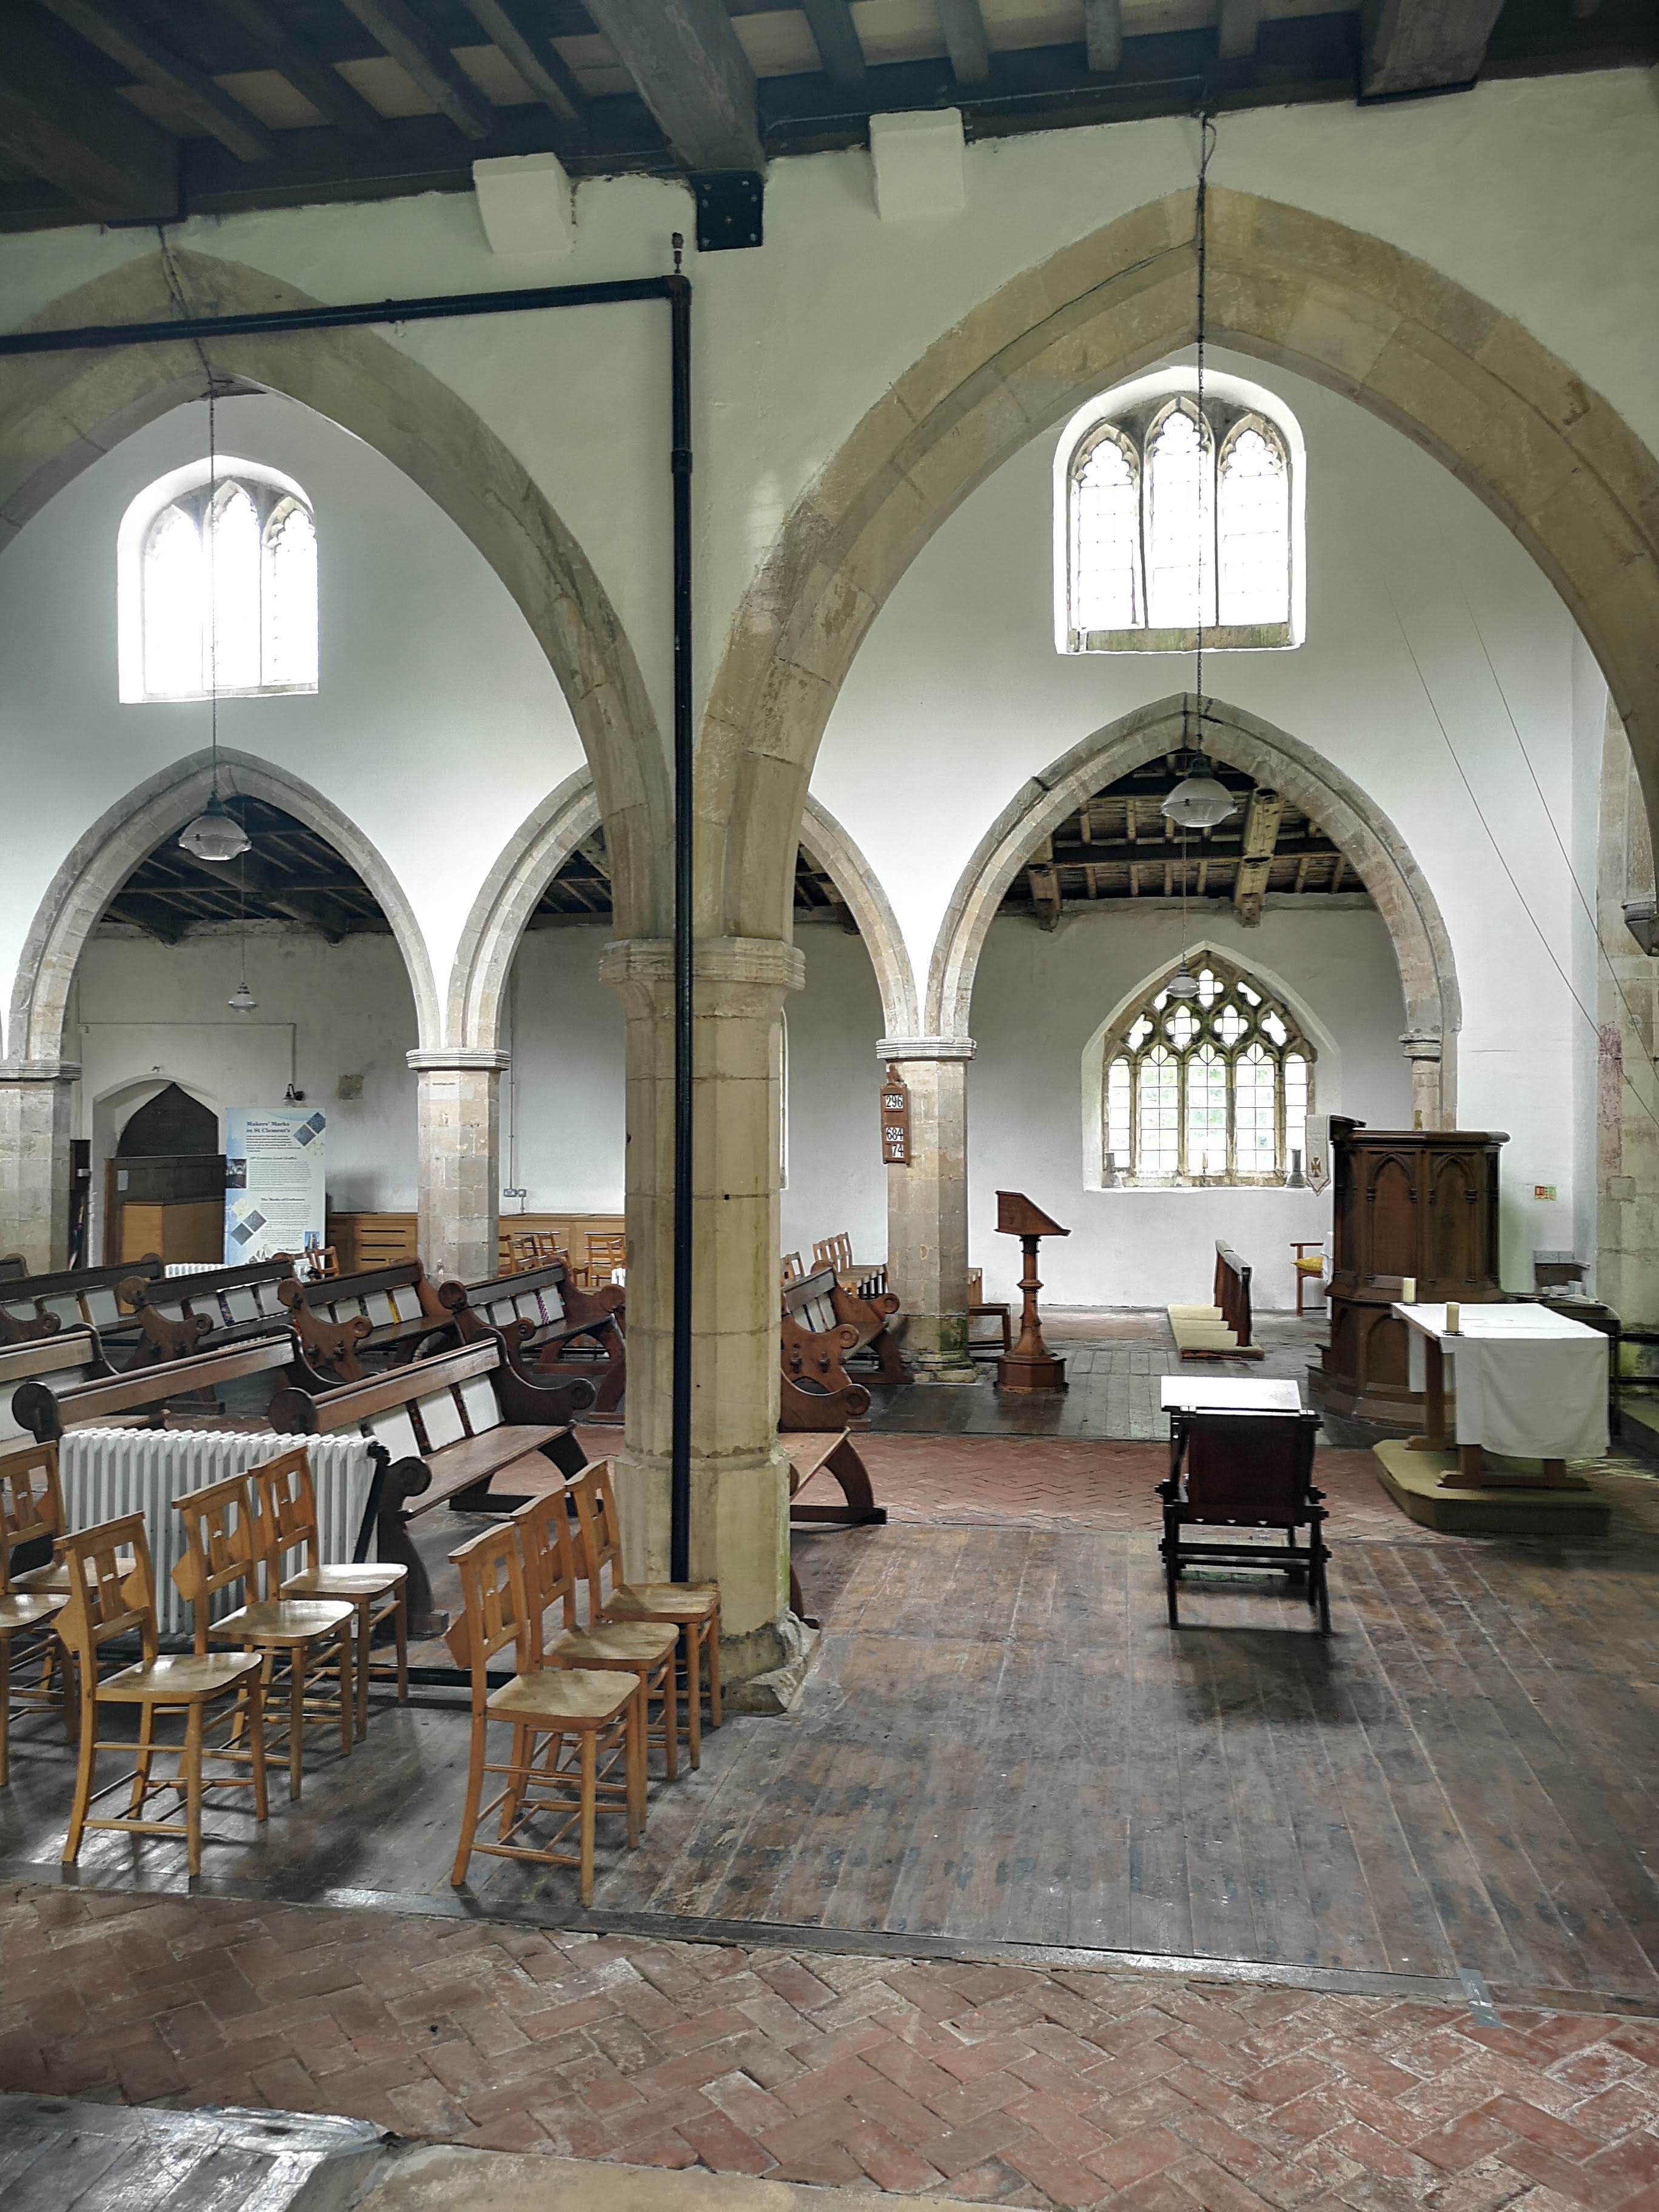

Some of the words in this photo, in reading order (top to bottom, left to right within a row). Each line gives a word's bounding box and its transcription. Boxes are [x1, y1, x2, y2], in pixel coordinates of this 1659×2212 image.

[886, 1095, 903, 1107] 296
[887, 1128, 903, 1140] 684
[893, 1144, 903, 1156] 74
